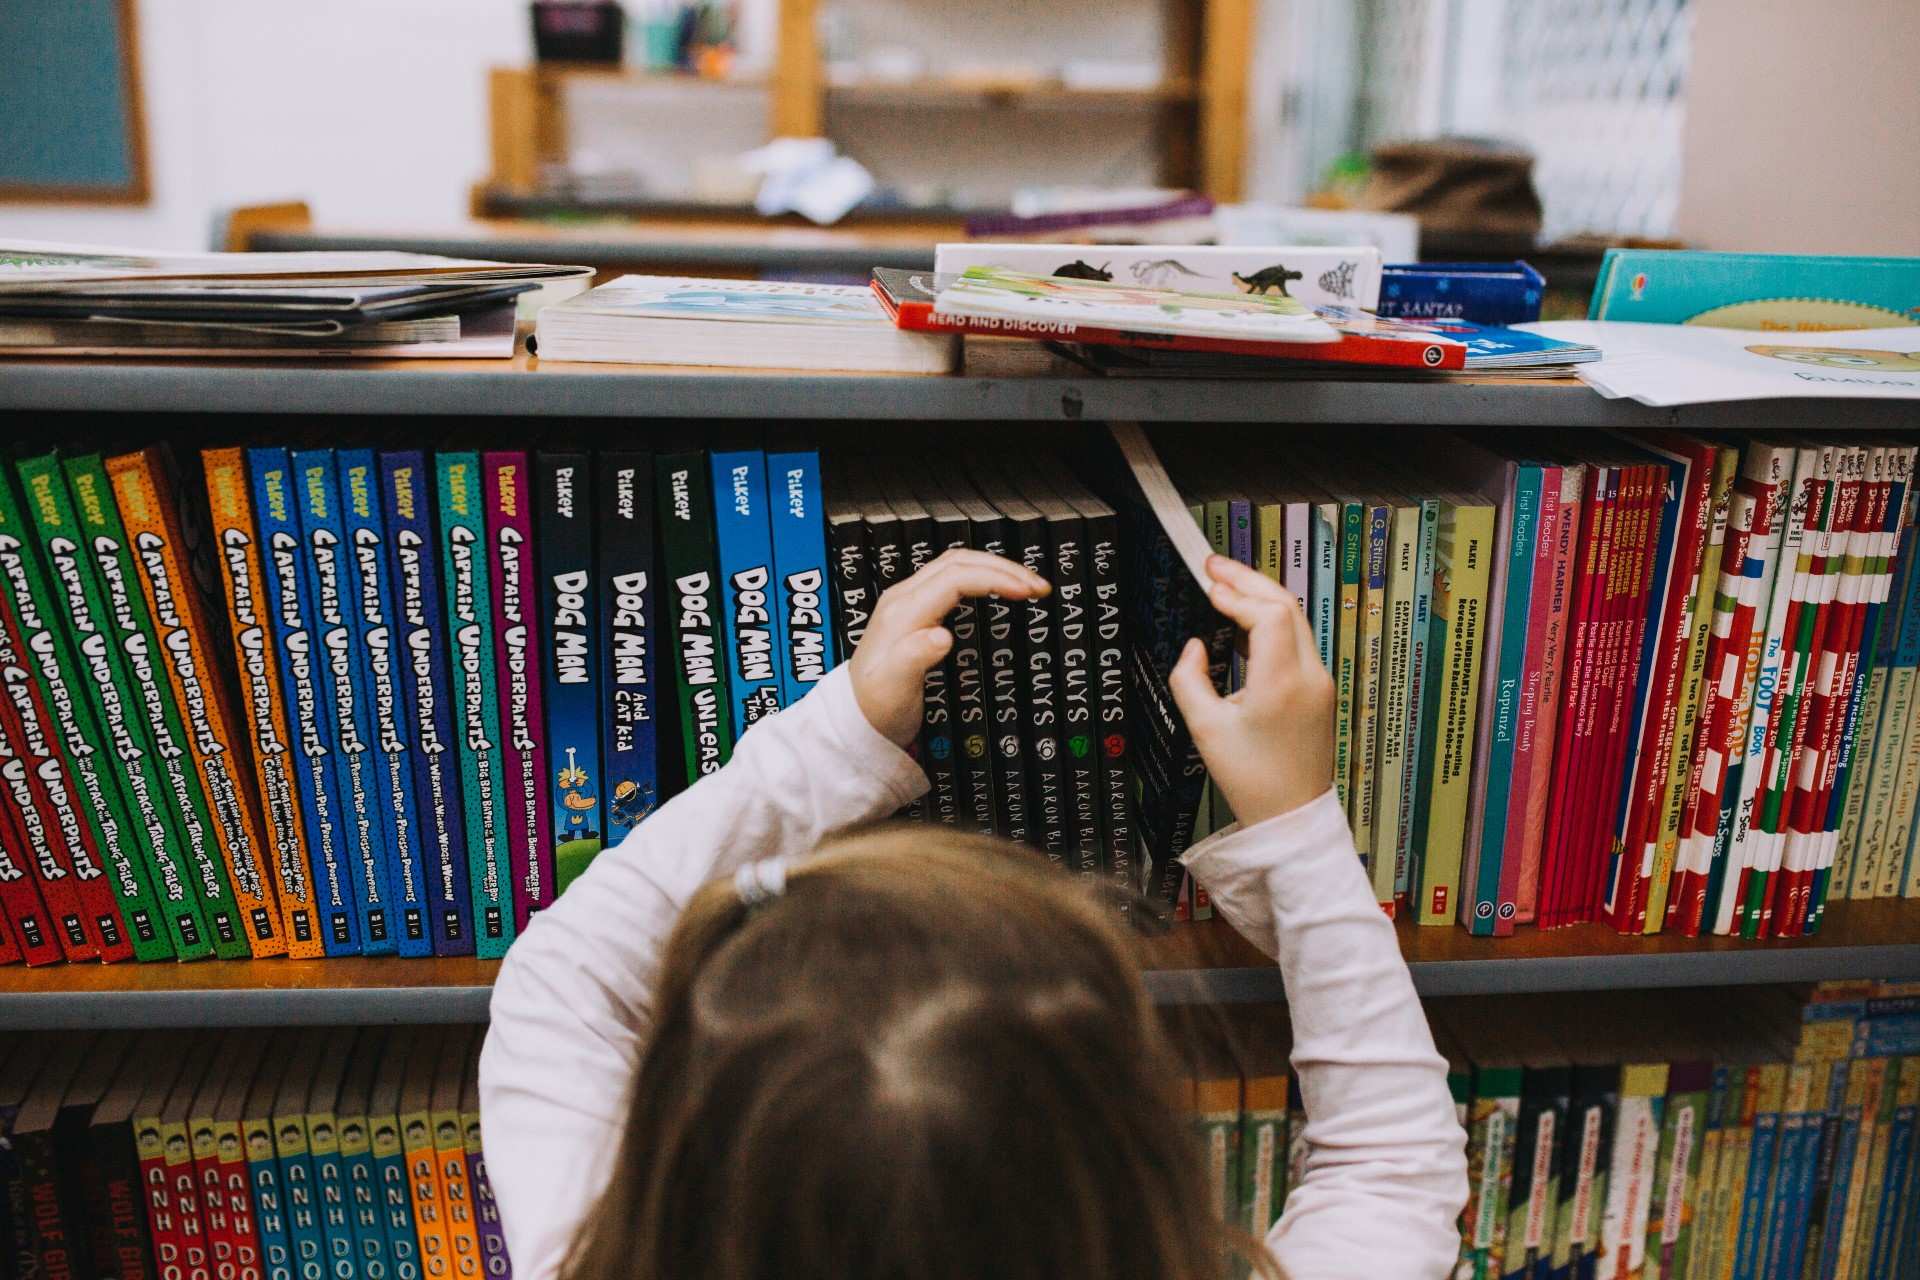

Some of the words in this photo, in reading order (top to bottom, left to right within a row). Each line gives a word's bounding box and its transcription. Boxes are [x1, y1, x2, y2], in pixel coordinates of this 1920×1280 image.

[927, 312, 966, 326] READ
[969, 316, 1000, 329] AND
[1003, 320, 1078, 335] DISCOVER
[1519, 490, 1533, 510] First
[1269, 540, 1277, 569] PILKEY
[1294, 539, 1302, 569] PILKEY
[1346, 533, 1358, 572] Stilton
[1372, 538, 1384, 576] Stilton
[1467, 539, 1478, 570] PILKEY
[1515, 514, 1531, 557] Readers
[1540, 515, 1556, 558] Readers
[1558, 507, 1573, 555] WENDY
[841, 545, 864, 580] the
[879, 544, 900, 579] the
[1058, 542, 1080, 575] the
[1094, 541, 1116, 575] the
[1402, 543, 1410, 572] PILKEY
[552, 570, 588, 627] DOG
[612, 571, 648, 627] DOG
[675, 571, 711, 628] DOG
[733, 566, 769, 623] DOG
[787, 568, 822, 625] DOG
[1060, 583, 1084, 640] BAD
[1096, 583, 1119, 640] BAD
[1552, 560, 1566, 614] HARMER
[843, 587, 869, 646] BAD
[1467, 598, 1477, 638] CAPTAIN
[555, 631, 589, 684] MAN
[613, 632, 647, 684] MAN
[679, 632, 718, 685] MAN
[739, 629, 773, 680] MAN
[792, 630, 826, 682] MAN
[1370, 636, 1380, 675] WATCH
[1461, 639, 1474, 696] UNDERPANTS
[1693, 649, 1704, 672] fish
[1745, 631, 1764, 683] HOP
[1767, 638, 1781, 658] The
[30, 630, 95, 759] UNDERPANTS
[82, 632, 143, 761] UNDERPANTS
[124, 632, 183, 759] UNDERPANTS
[167, 628, 224, 755] UNDERPANTS
[240, 627, 287, 755] UNDERPANTS
[286, 631, 328, 757] UNDERPANTS
[325, 627, 366, 754] UNDERPANTS
[366, 626, 406, 753] UNDERPANTS
[407, 627, 445, 754] UNDERPANTS
[457, 624, 492, 752] UNDERPANTS
[504, 625, 536, 752] UNDERPANTS
[957, 648, 982, 723] GUYS
[992, 648, 1018, 723] GUYS
[1030, 652, 1055, 726] GUYS
[1064, 649, 1089, 722] GUYS
[1100, 648, 1124, 722] GUYS
[1341, 657, 1351, 696] ATTACK
[1368, 680, 1377, 710] YOUR
[1522, 671, 1540, 716] Sleeping
[1688, 678, 1698, 701] two
[1755, 666, 1778, 715] FOOT
[615, 690, 632, 722] CAT
[1339, 719, 1348, 737] THE
[1340, 700, 1349, 714] OF
[1497, 679, 1516, 743] Rapunzel
[1685, 704, 1697, 727] fish
[1002, 736, 1018, 757] 6
[1038, 738, 1055, 760] 6
[1337, 741, 1347, 780] BANDIT
[1519, 719, 1537, 754] Beauty
[1679, 734, 1689, 752] red
[1676, 754, 1689, 777] fish
[2, 758, 67, 880] UNDERPANTS
[37, 758, 102, 881] UNDERPANTS
[1005, 770, 1022, 822] AARON
[1041, 772, 1058, 825] AARON
[1074, 769, 1092, 821] AARON
[1109, 769, 1127, 821] AARON
[1668, 809, 1680, 832] fish
[1671, 784, 1684, 809] blue
[150, 1167, 173, 1232] ANH
[177, 1175, 199, 1236] ANH
[204, 1168, 226, 1231] ANH
[228, 1173, 250, 1235] ANH
[258, 1169, 281, 1233] ANH
[290, 1164, 313, 1228] ANH
[322, 1162, 345, 1226] ANH
[352, 1163, 375, 1226] ANH
[385, 1165, 407, 1228] ANH
[415, 1159, 437, 1224] ANH
[445, 1159, 468, 1223] ANH
[214, 1240, 236, 1280] DO
[300, 1239, 321, 1280] DO
[332, 1237, 354, 1280] DO
[363, 1238, 385, 1280] DO
[395, 1240, 416, 1280] DO
[425, 1233, 447, 1276] DO
[455, 1233, 477, 1276] DO
